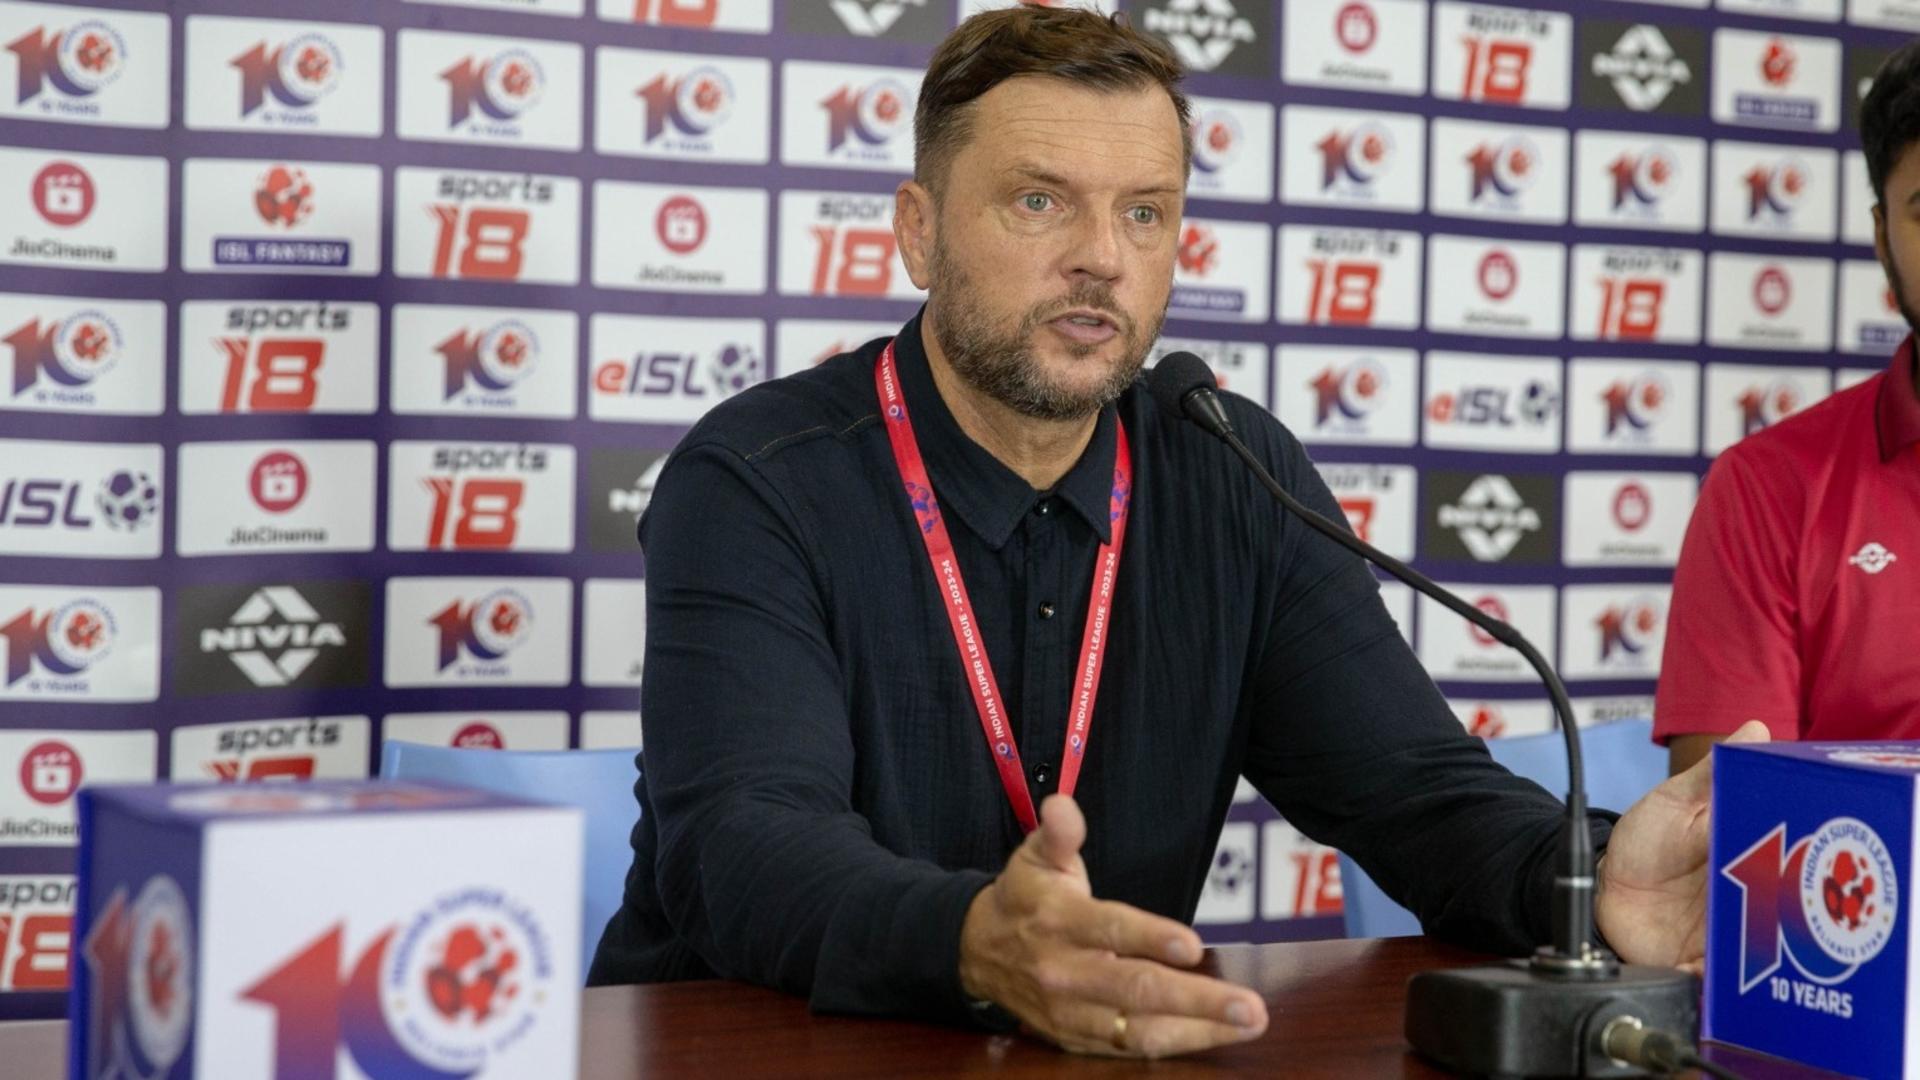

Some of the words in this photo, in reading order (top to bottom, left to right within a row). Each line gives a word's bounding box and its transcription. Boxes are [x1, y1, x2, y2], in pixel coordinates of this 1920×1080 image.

[1460, 34, 1532, 106] 18
[437, 174, 554, 204] sports
[818, 196, 889, 220] spor
[10, 237, 117, 262] JioCinema
[218, 241, 251, 262] ISL
[259, 241, 347, 263] FANTASY
[424, 204, 532, 280] 18
[808, 226, 898, 297] 18
[1305, 259, 1382, 327] 18
[1595, 276, 1667, 343] 18
[225, 300, 350, 333] sports
[211, 336, 327, 415] 18
[594, 353, 706, 397] eISL
[432, 442, 548, 473] sports
[419, 477, 525, 547] 18
[941, 559, 963, 606] 2023-24
[199, 622, 347, 652] NIVIA
[958, 614, 980, 660] LEAGUE
[1075, 689, 1090, 731] INDIAN
[1083, 651, 1097, 689] SUPER
[1091, 606, 1107, 651] LEAGUE
[1101, 552, 1116, 599] 2023-24
[972, 660, 992, 698] SUPER
[216, 718, 342, 752] sports
[983, 695, 1005, 740] INDIAN
[1804, 834, 1831, 891] INDIAN
[1829, 823, 1868, 844] SUPER
[1867, 839, 1894, 905] LEAGUE
[0, 882, 78, 908] spor
[1769, 976, 1788, 1003] 10
[1791, 979, 1854, 1019] YEARS
